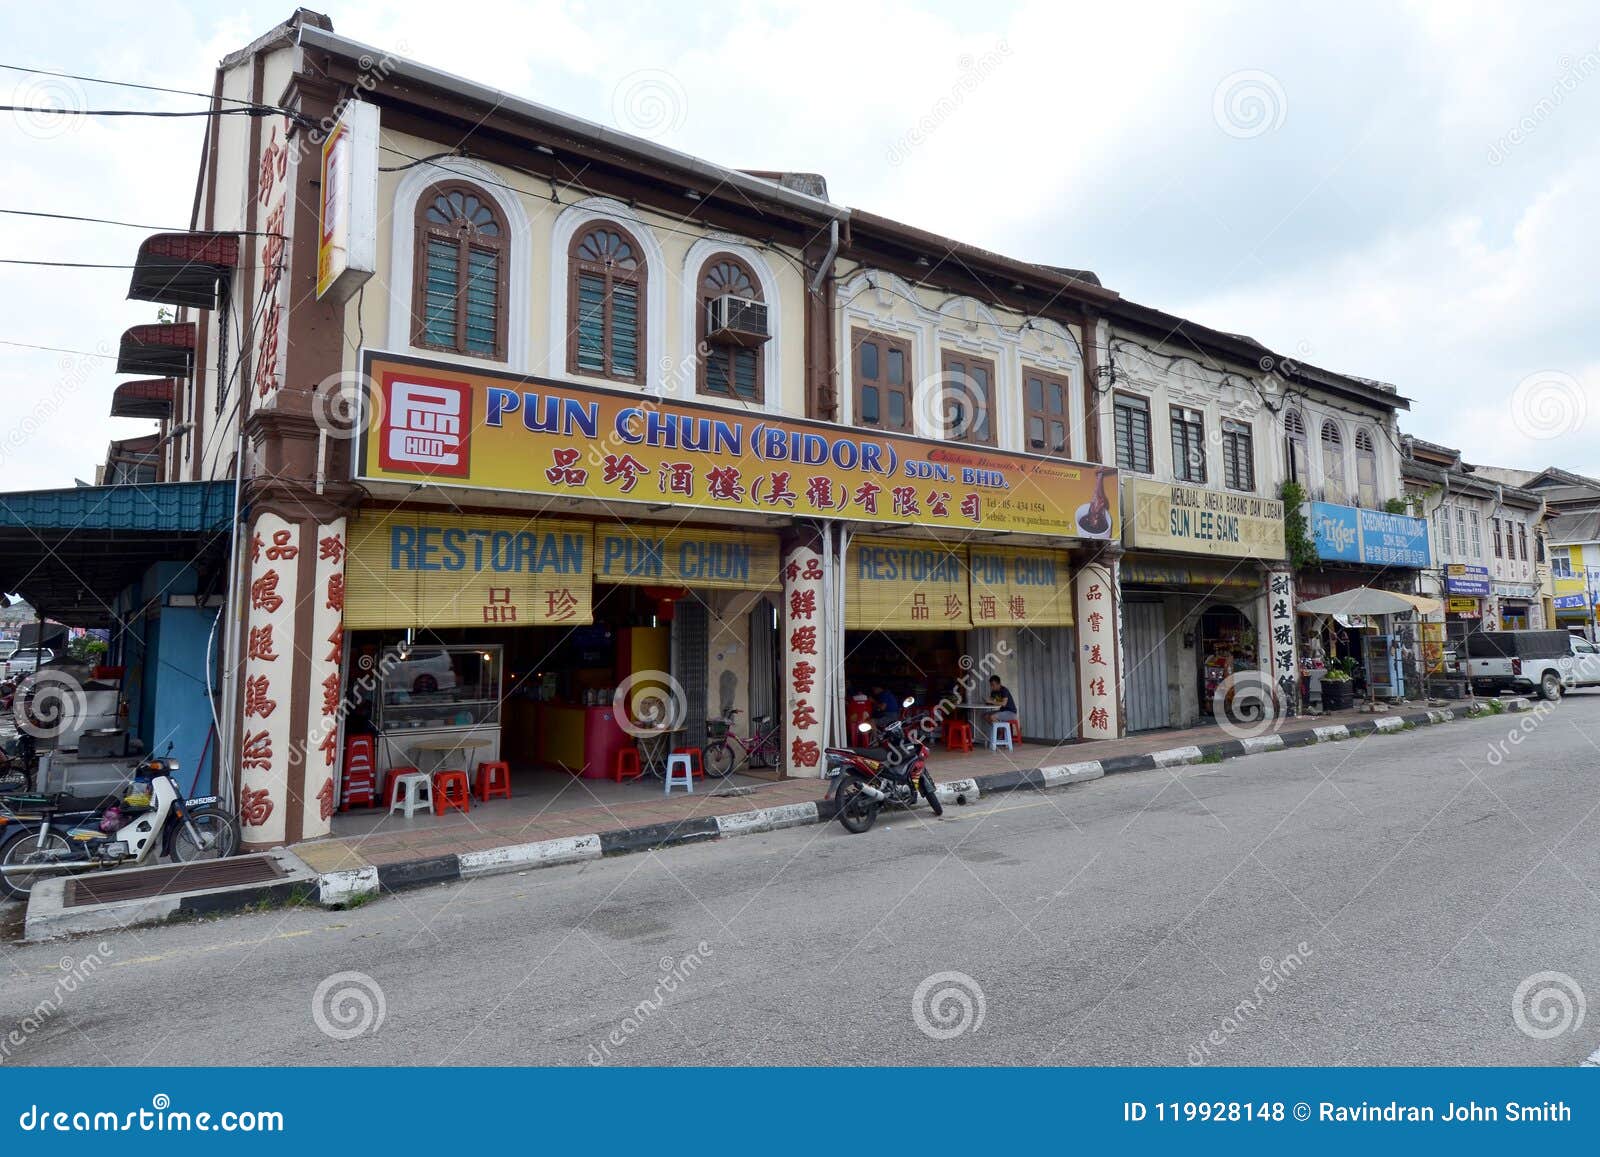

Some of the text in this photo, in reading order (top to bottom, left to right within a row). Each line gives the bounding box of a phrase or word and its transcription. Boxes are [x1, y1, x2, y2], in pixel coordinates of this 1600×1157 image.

[485, 386, 1009, 489] PUN CHUN (BIDOR) SDN. BHD.
[1030, 464, 1078, 479] Restaurant
[1171, 488, 1283, 520] MENJUAL ANEKA BARANG DAN LOGAM
[1170, 508, 1190, 537] SUN
[1194, 511, 1213, 540] LEE
[1216, 514, 1239, 543] SANG
[1322, 517, 1356, 553] Tiger
[391, 525, 749, 580] RESTORAN PUN CHUN
[859, 546, 1057, 586] RESTORAN PUN CHUN
